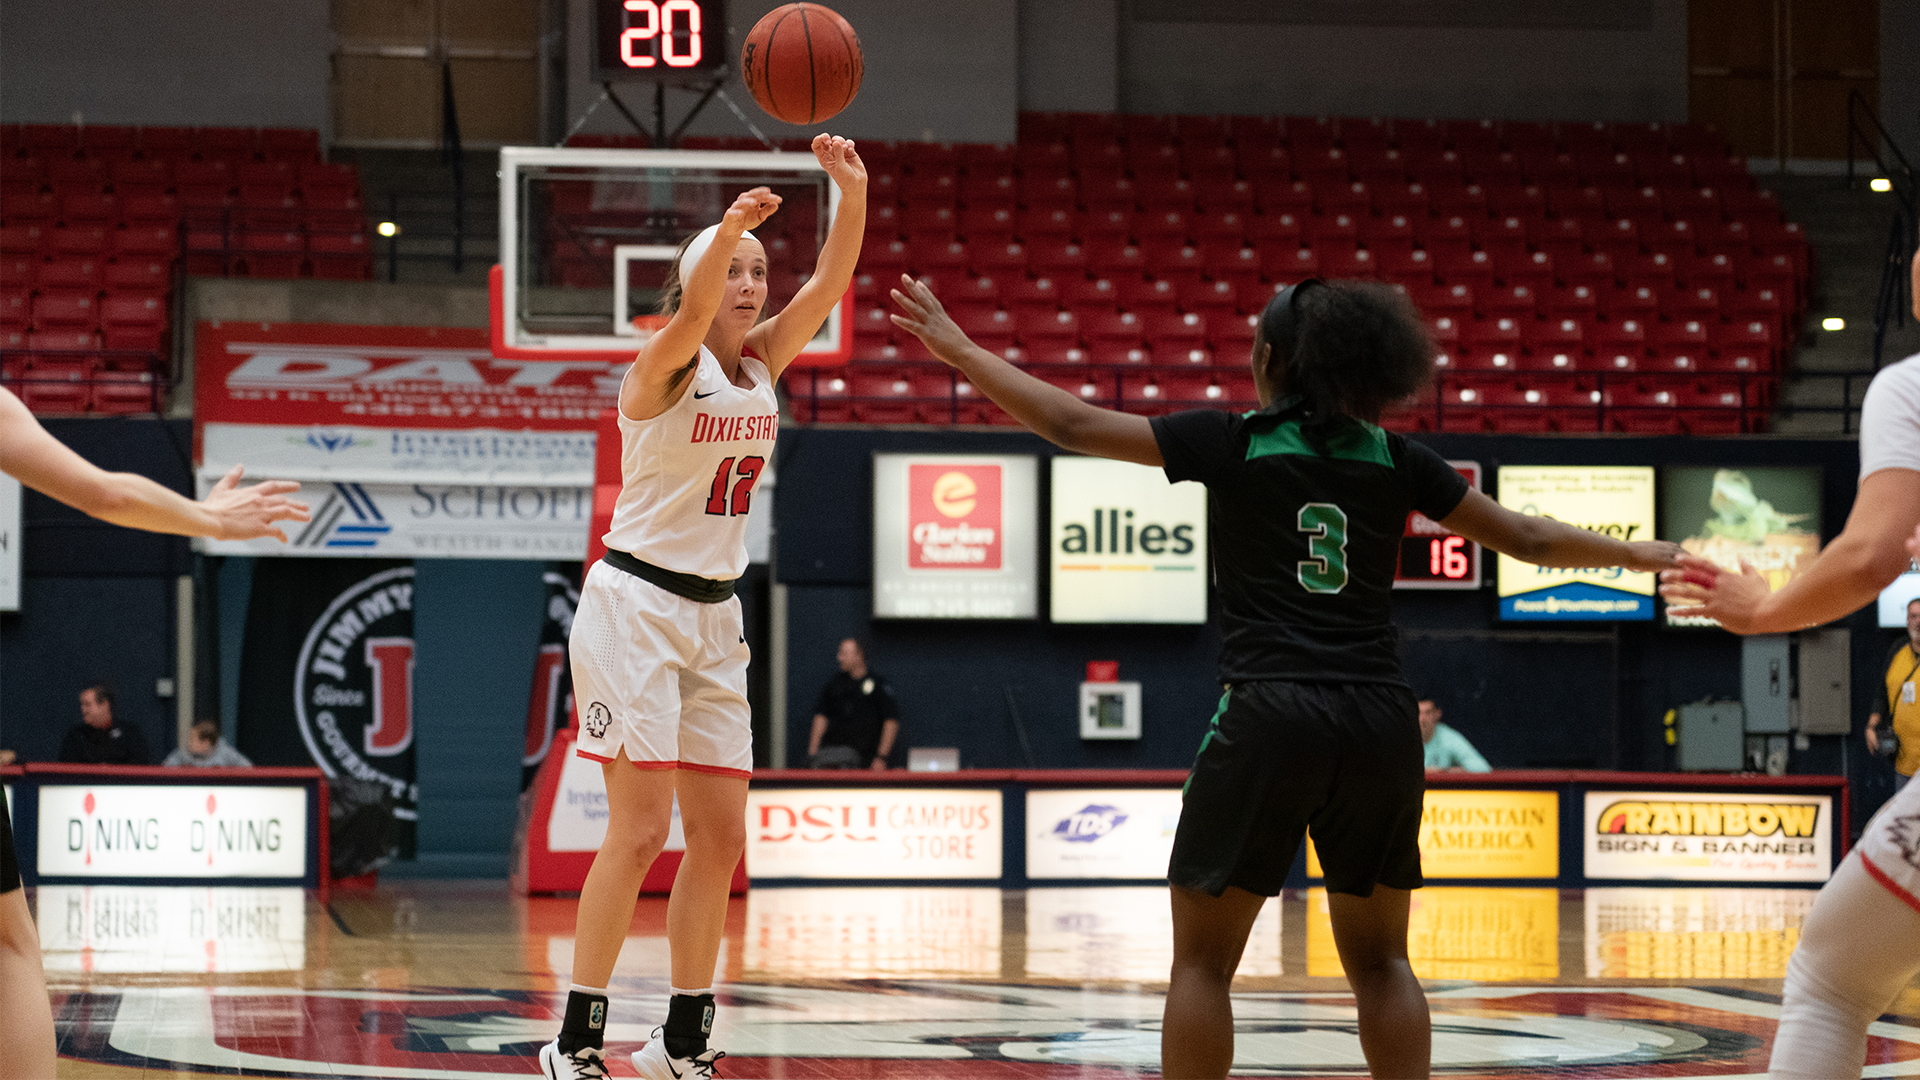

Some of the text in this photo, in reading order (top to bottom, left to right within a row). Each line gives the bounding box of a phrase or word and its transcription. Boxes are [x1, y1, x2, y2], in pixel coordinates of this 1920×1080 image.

[620, 0, 701, 67] 20
[225, 342, 629, 394] DAT
[690, 411, 779, 443] DIXIE STAT
[411, 484, 583, 520] SCHOFI
[705, 455, 765, 517] 12
[913, 521, 995, 546] Clarion
[1060, 508, 1195, 555] allies
[1297, 502, 1348, 594] 3
[1430, 536, 1468, 579] 16
[311, 583, 413, 681] JIMMY
[365, 637, 414, 757] J
[758, 804, 990, 842] DSU CAMPUS
[1067, 813, 1115, 837] TDS
[1423, 805, 1545, 826] MOUNTAIN
[1598, 801, 1820, 838] RAINBOW
[902, 834, 976, 860] STORE
[1427, 830, 1534, 850] AMERICA
[1597, 840, 1816, 855] SIGN & BANNER
